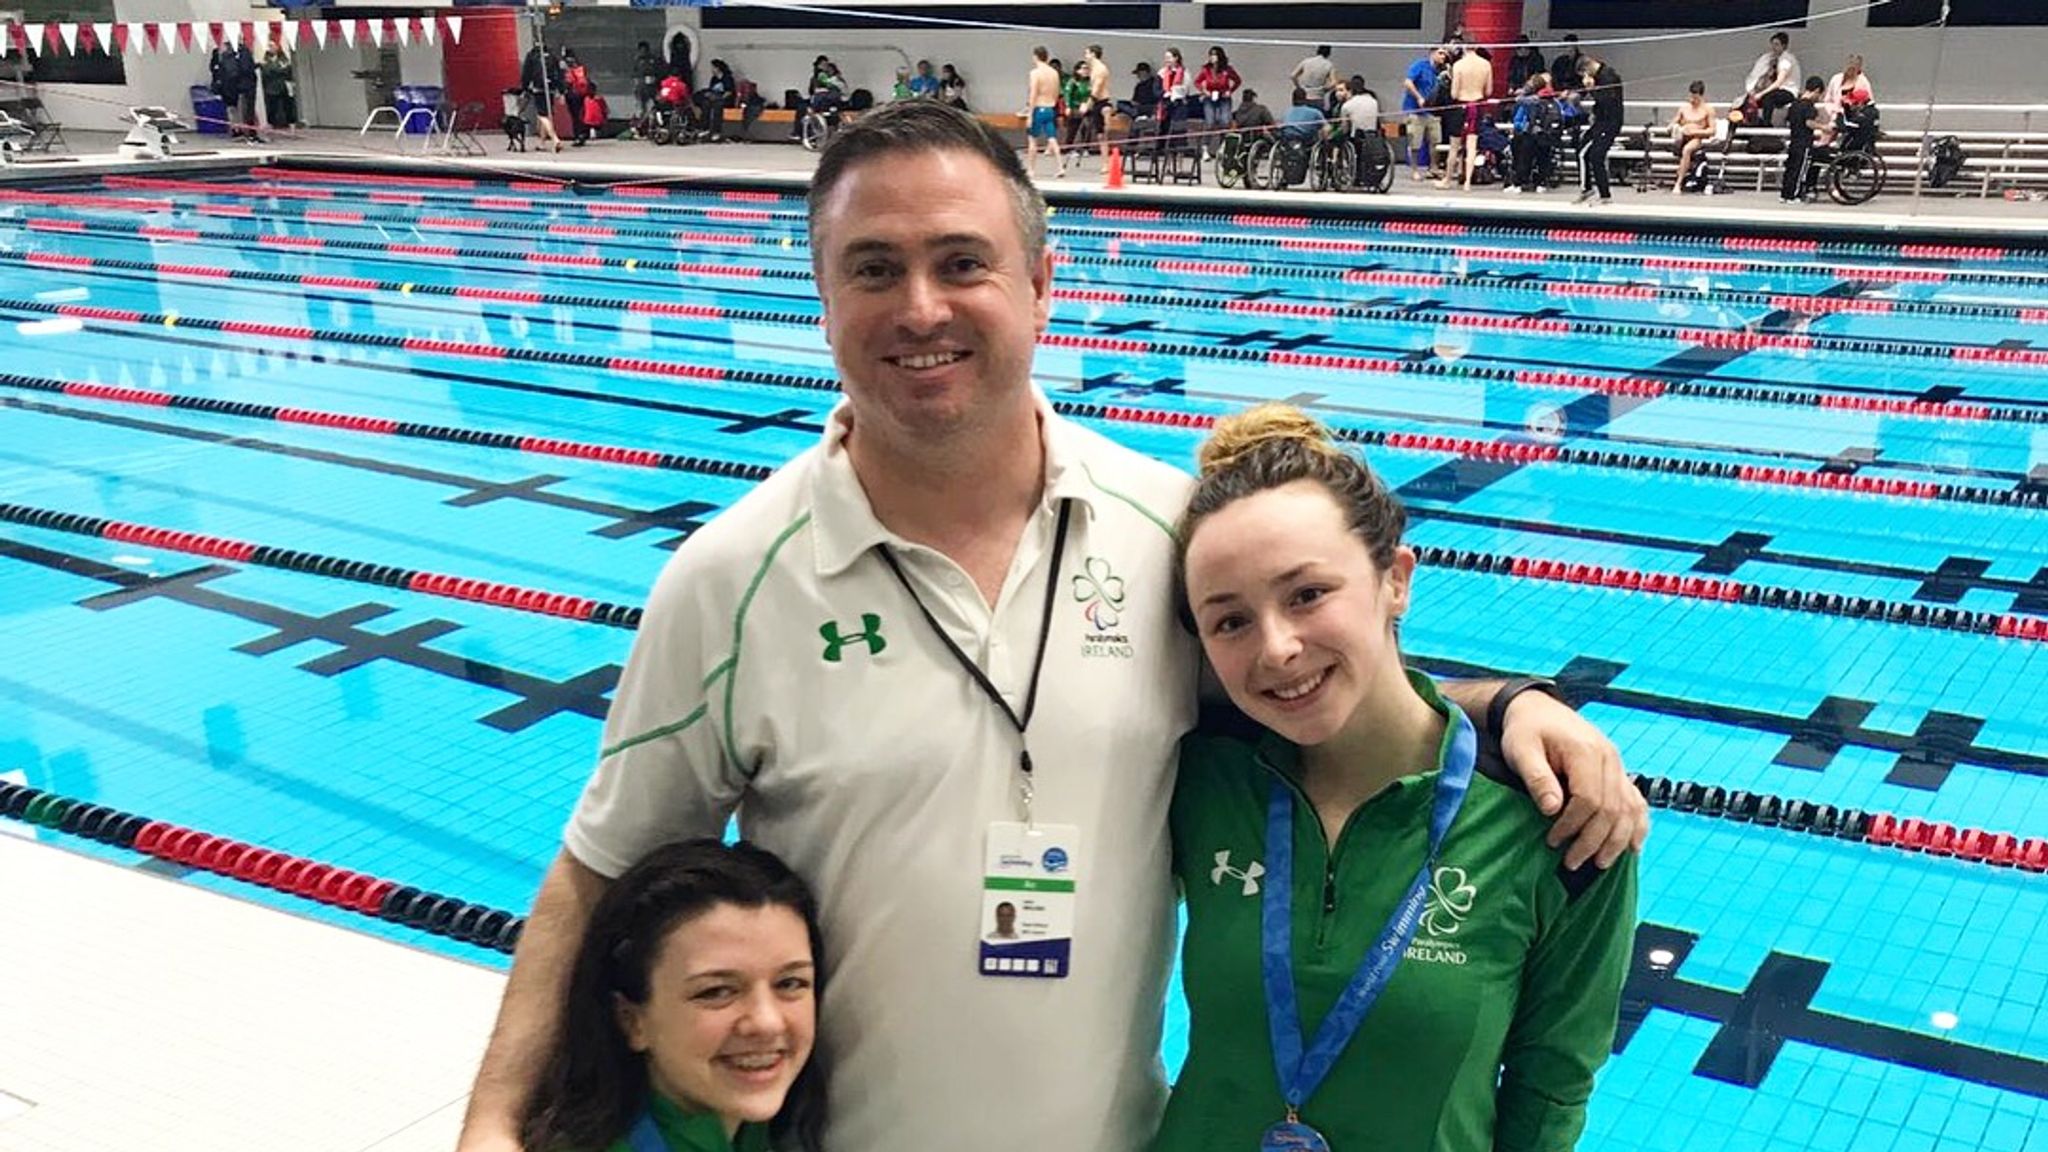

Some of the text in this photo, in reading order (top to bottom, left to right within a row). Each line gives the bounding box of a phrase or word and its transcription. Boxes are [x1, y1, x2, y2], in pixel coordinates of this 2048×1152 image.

[1081, 645, 1134, 658] IRELAND
[1381, 885, 1426, 955] Swimming
[1403, 947, 1467, 964] IRELAND
